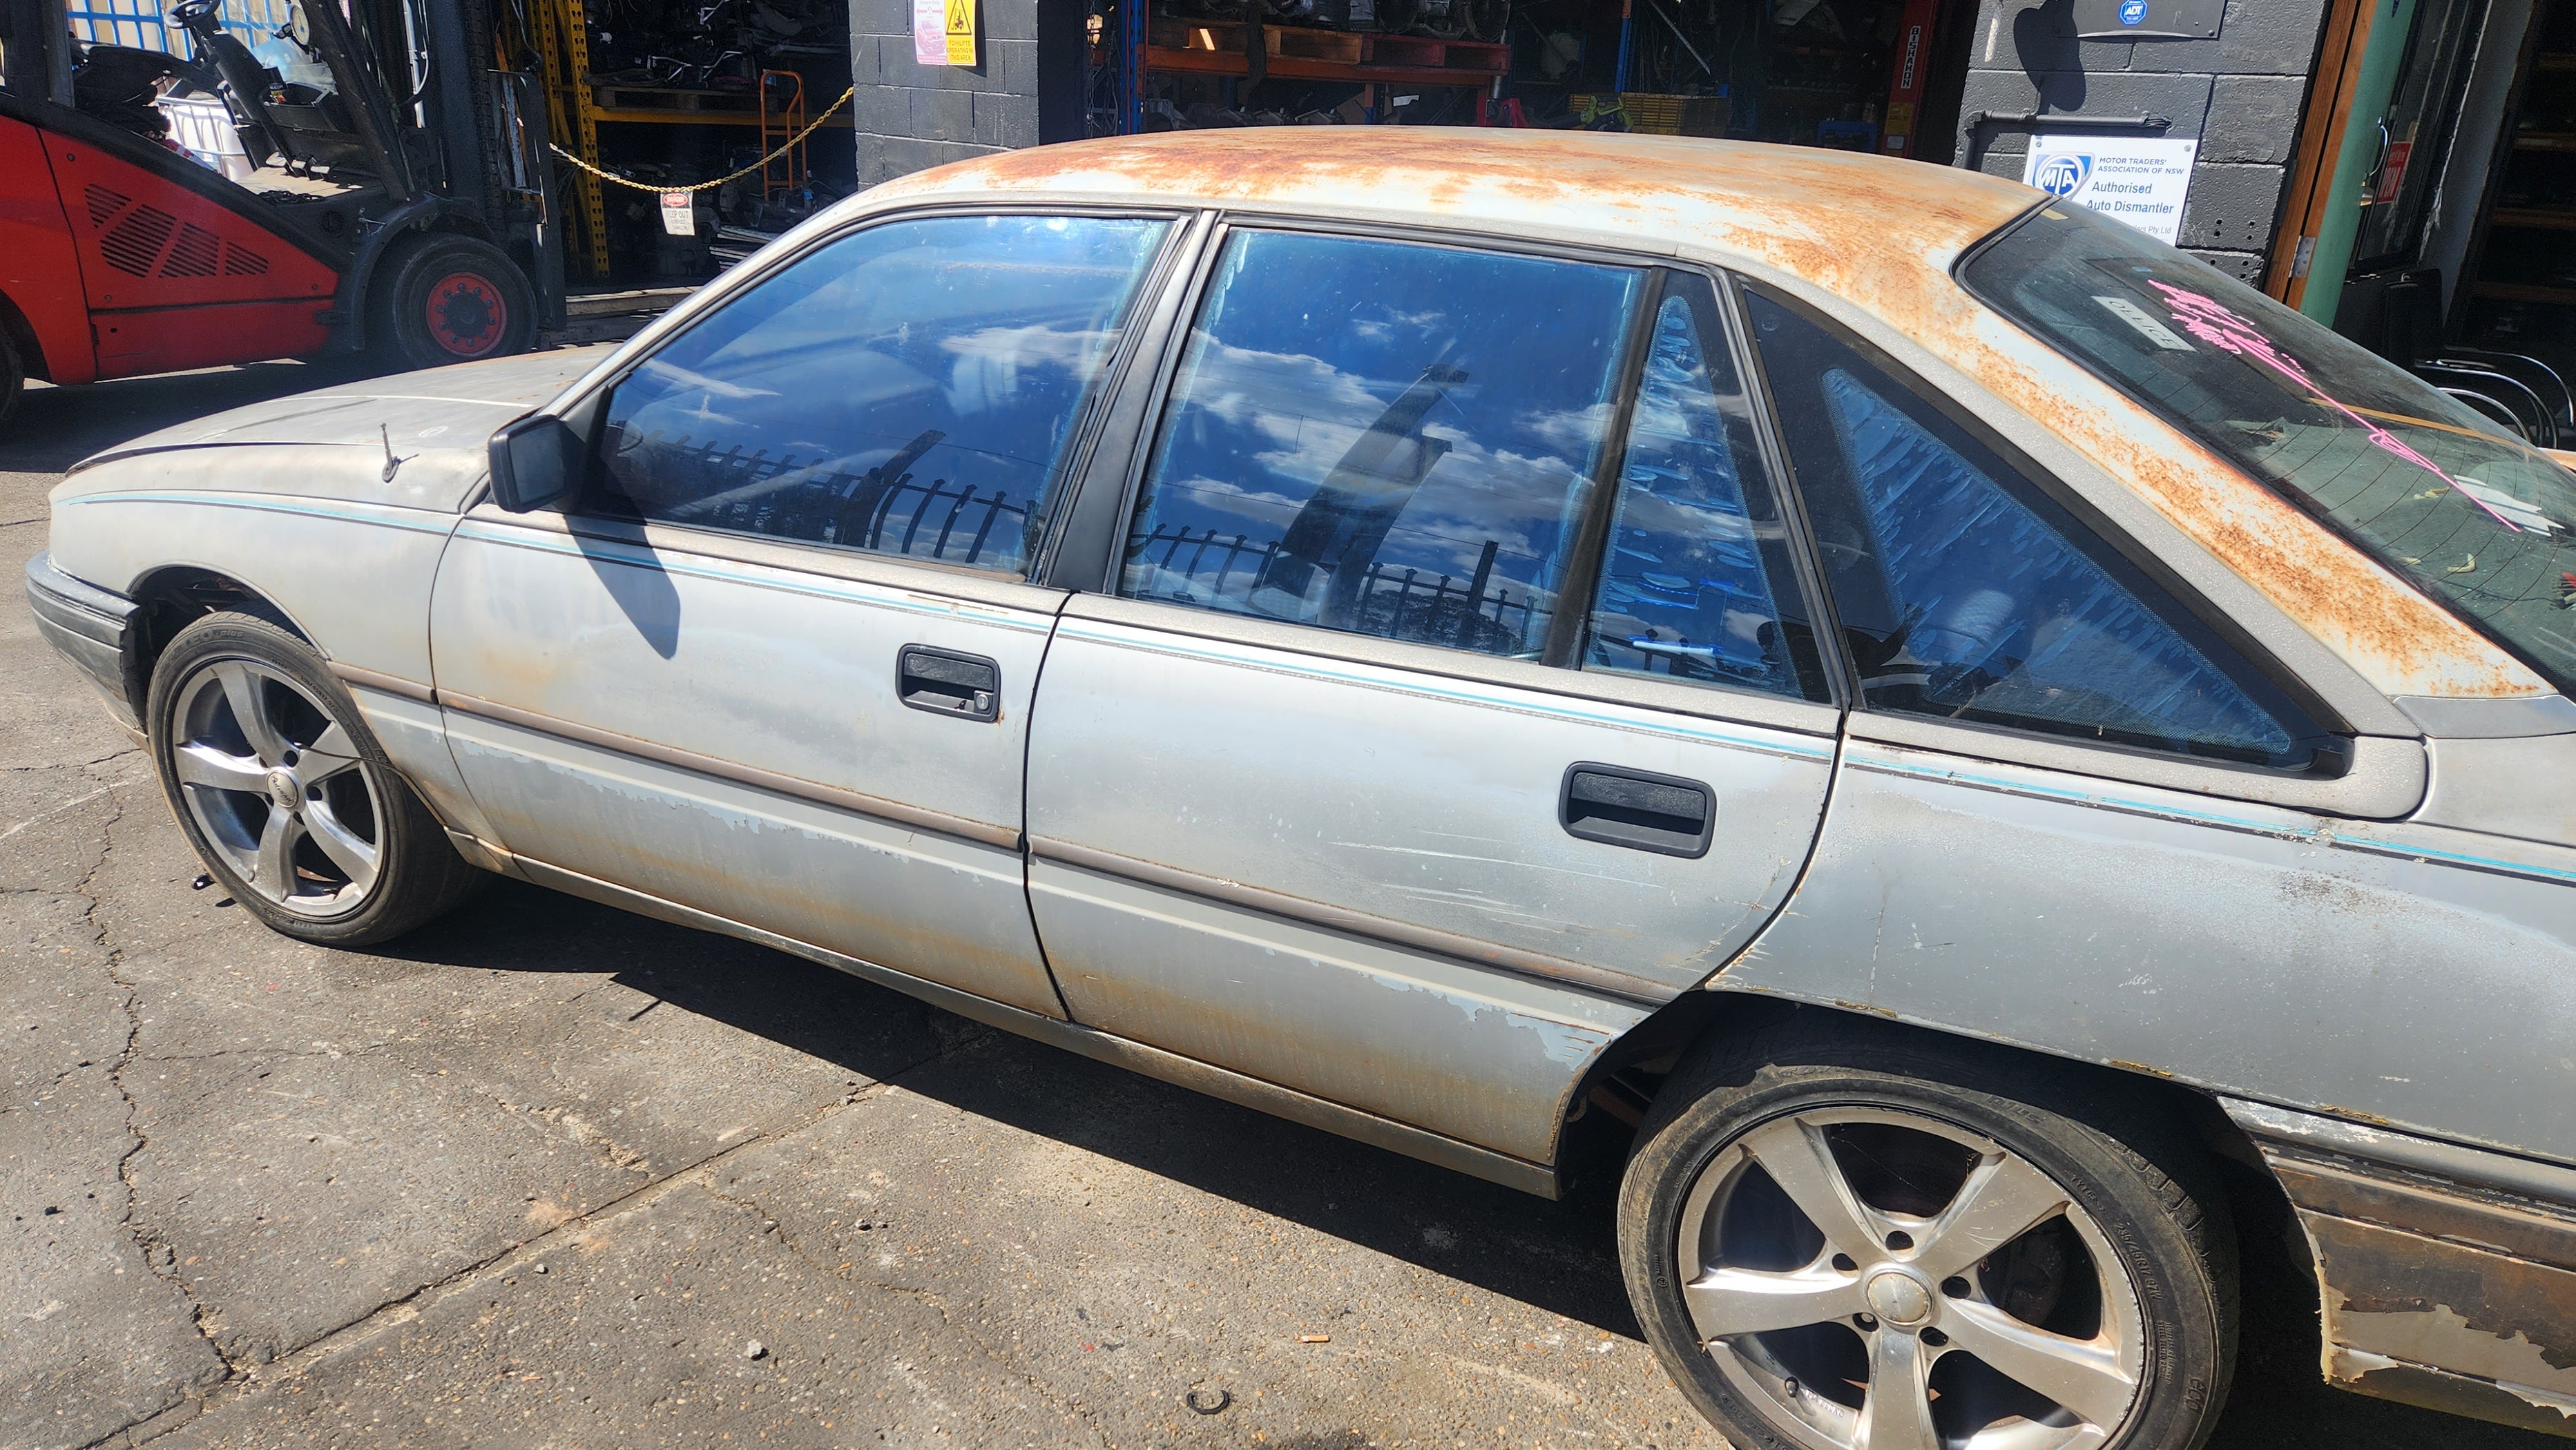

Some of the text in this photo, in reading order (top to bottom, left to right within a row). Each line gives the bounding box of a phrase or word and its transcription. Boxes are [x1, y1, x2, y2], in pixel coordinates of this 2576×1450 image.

[2124, 6, 2143, 15] ADT
[1903, 27, 1920, 87] BISHAMON
[2041, 164, 2077, 196] MTA
[2092, 182, 2153, 194] Authorised
[2086, 200, 2174, 213] Auto Dismantler
[678, 210, 689, 218] OUT
[2149, 226, 2159, 235] Pty
[2108, 300, 2178, 347] OFFICE
[220, 629, 245, 637] plus
[2113, 1223, 2163, 1301] 235/45R17 97W
